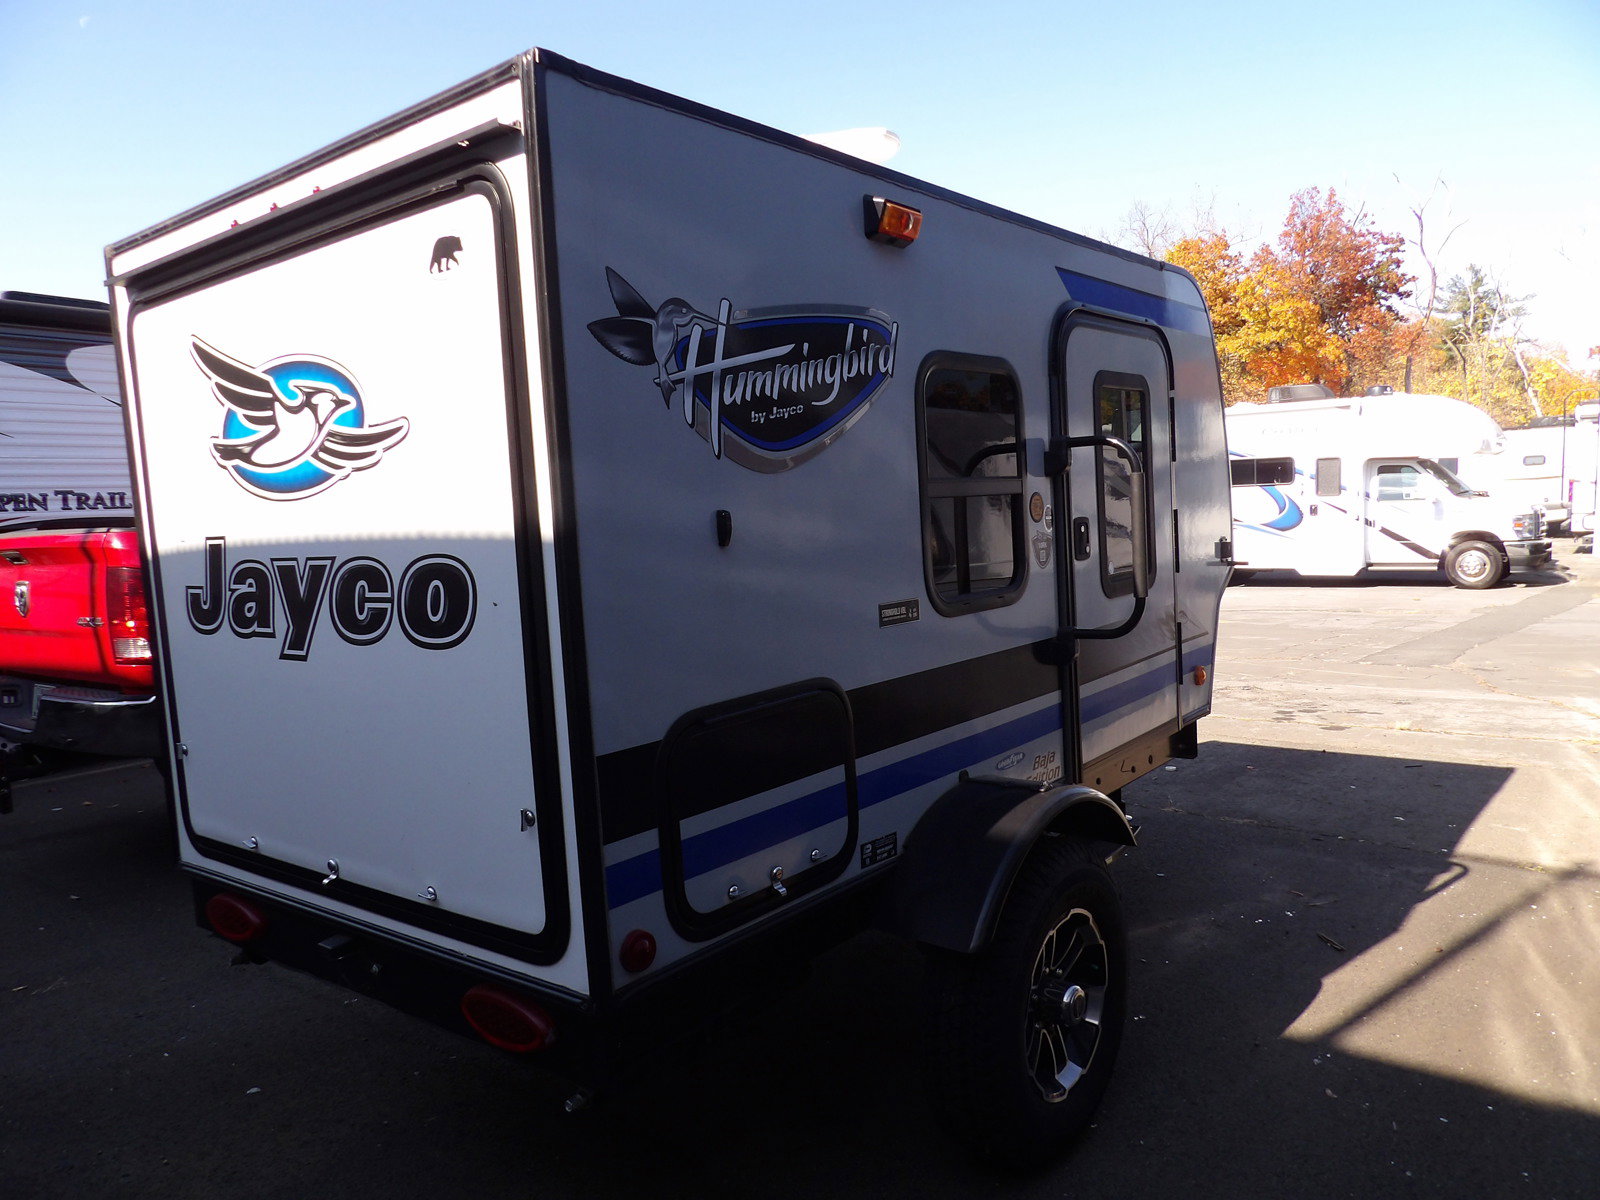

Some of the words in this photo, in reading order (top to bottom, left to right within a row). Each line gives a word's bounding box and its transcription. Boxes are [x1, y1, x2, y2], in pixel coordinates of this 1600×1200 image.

[653, 298, 898, 460] Hummingbird
[751, 410, 766, 424] by
[769, 404, 804, 419] Jayco
[186, 536, 478, 662] Jayco
[1033, 751, 1056, 771] Baja
